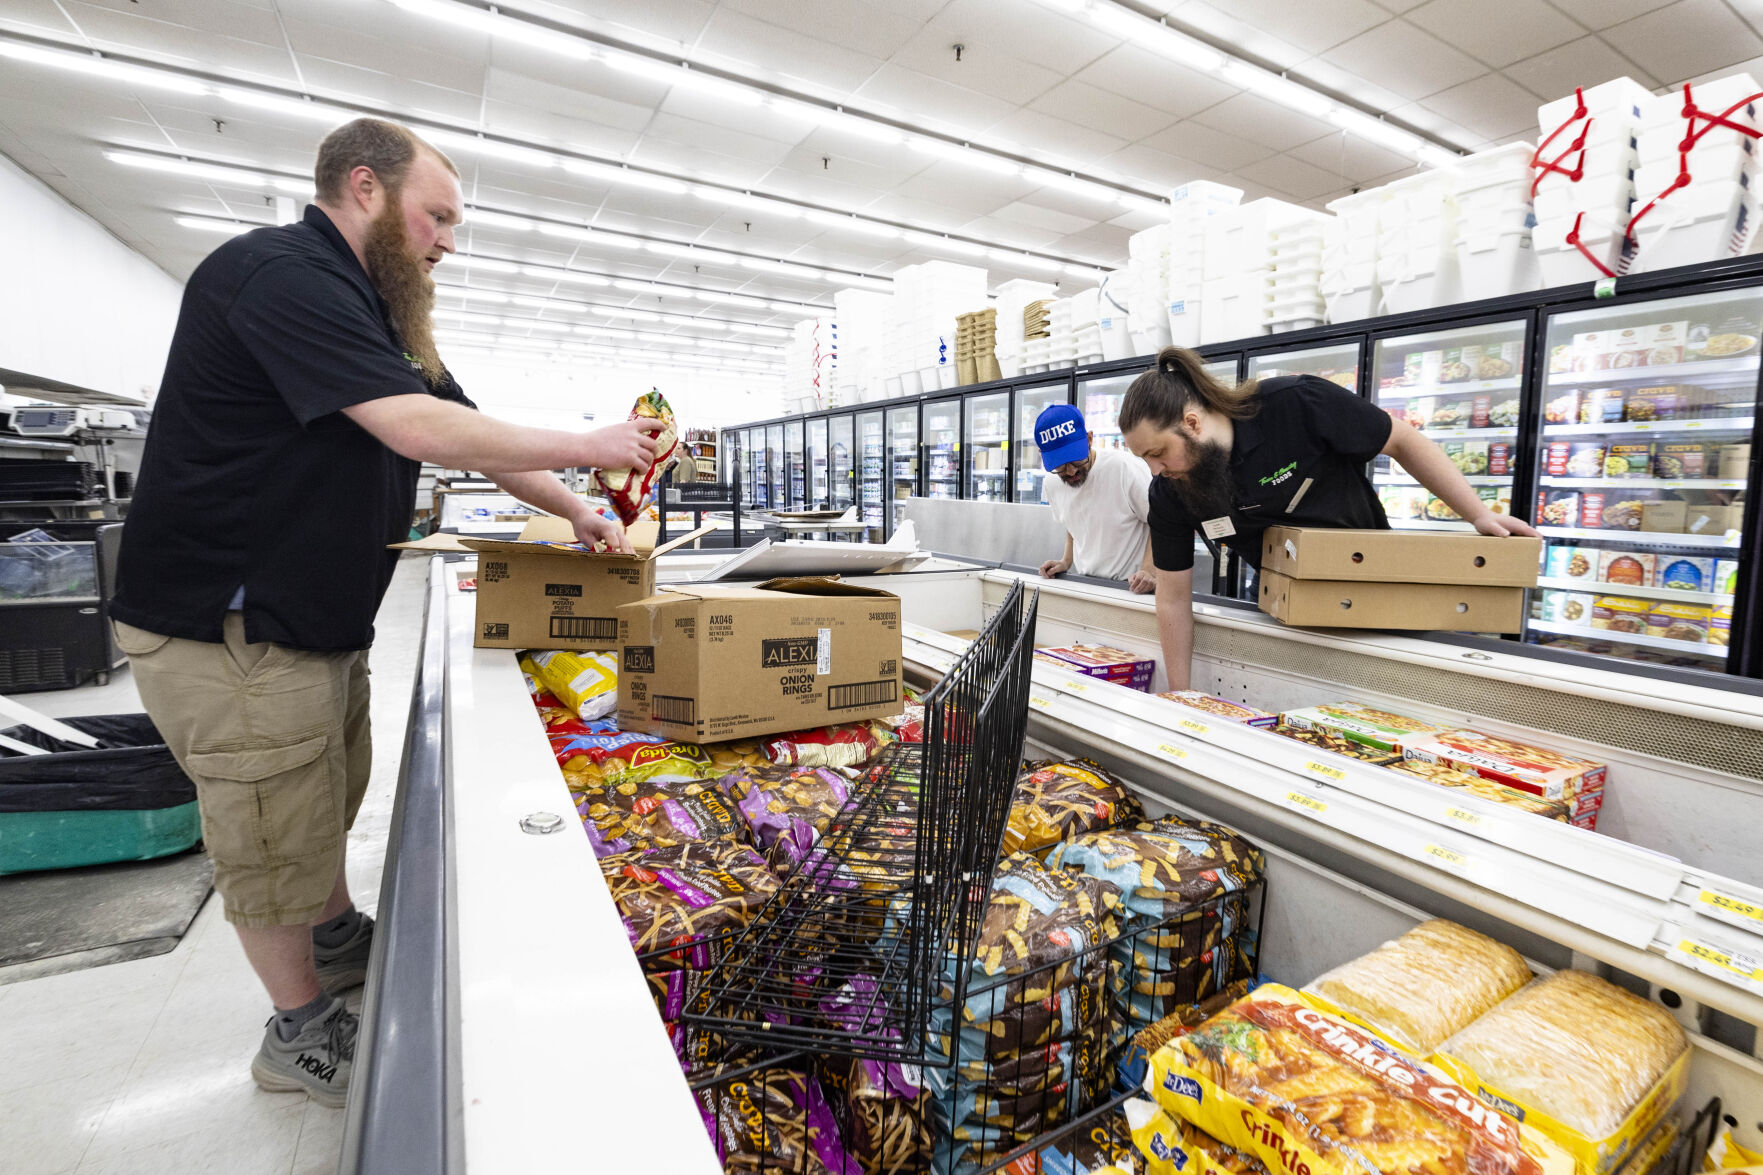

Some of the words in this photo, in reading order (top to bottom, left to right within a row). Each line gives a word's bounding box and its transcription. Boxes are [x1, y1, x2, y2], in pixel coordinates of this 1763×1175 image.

[1039, 419, 1076, 444] DUKE
[1271, 470, 1293, 486] FOODS
[547, 587, 580, 595] ALEXIA
[709, 614, 733, 625] AX046
[625, 654, 653, 669] ALEXIA
[787, 666, 807, 674] crispy
[780, 674, 815, 686] ONION
[631, 682, 647, 692] ONION
[782, 684, 813, 696] RINGS
[631, 691, 646, 701] RINGS
[639, 743, 700, 758] Ore-Ida
[295, 1053, 338, 1083] HOKA
[1294, 1008, 1415, 1085] Crinkle
[1428, 1085, 1509, 1142] Cut
[1240, 1110, 1311, 1175] Crinkle
